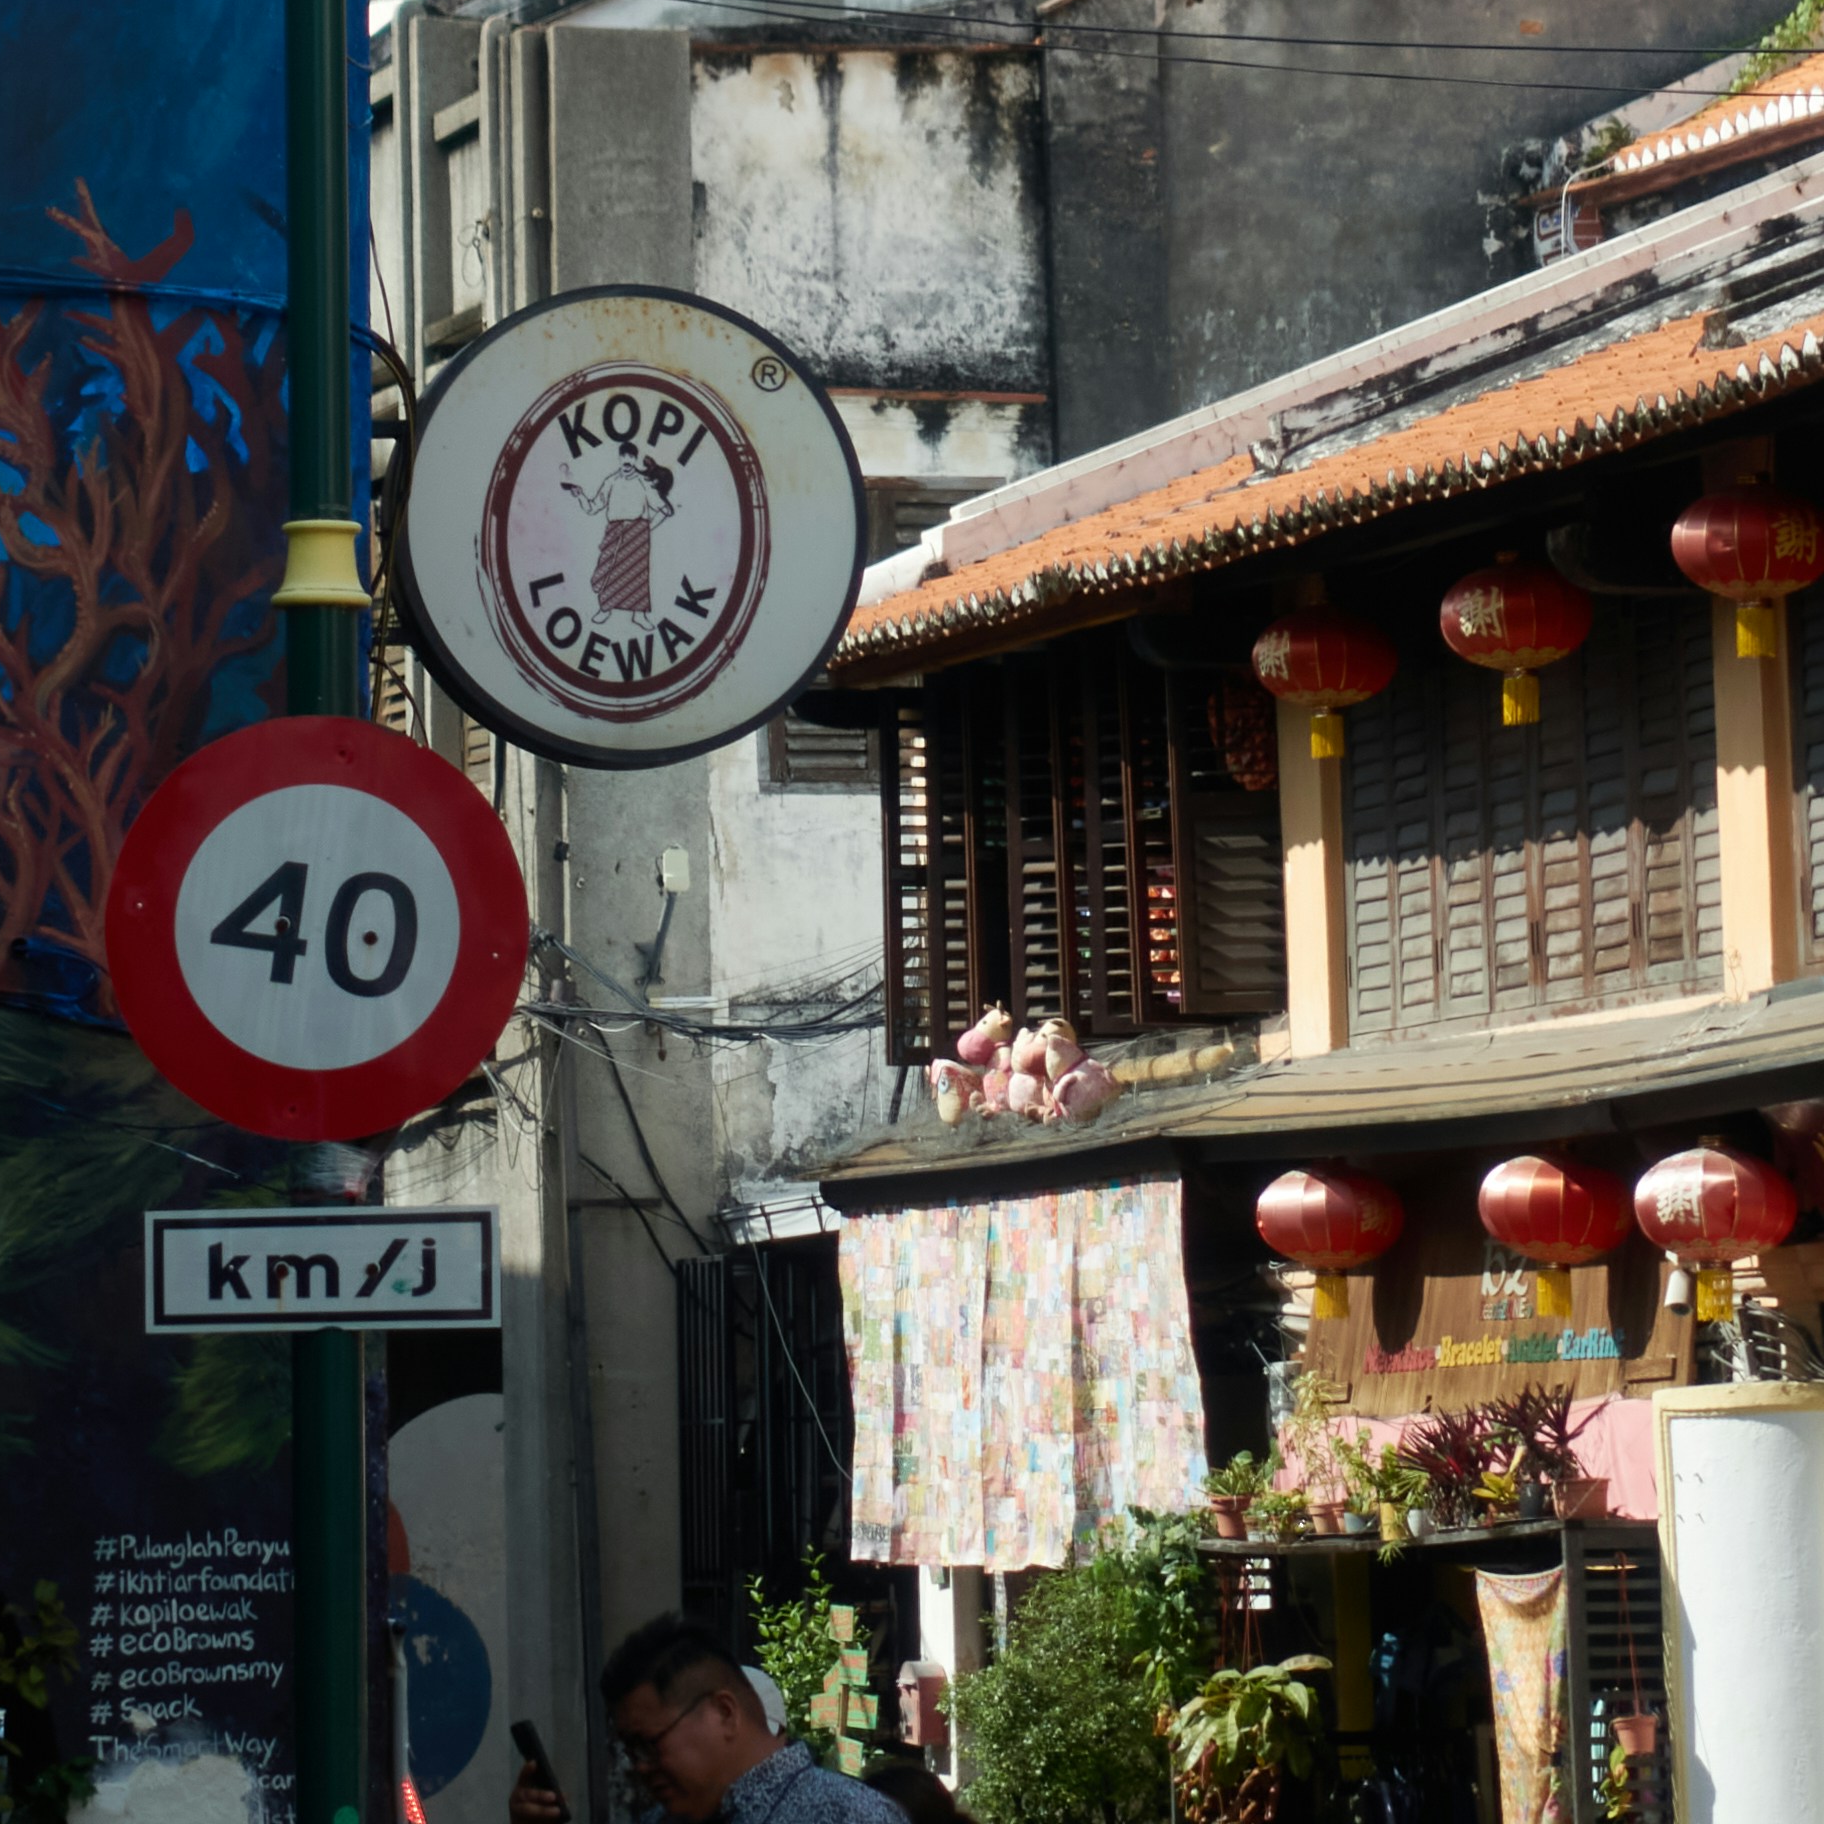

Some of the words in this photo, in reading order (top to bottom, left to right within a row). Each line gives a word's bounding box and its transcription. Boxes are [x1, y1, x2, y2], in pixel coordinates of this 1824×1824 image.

[558, 393, 710, 467] KOPI
[529, 571, 717, 682] LOEWAK
[210, 860, 418, 997] 40
[208, 1237, 438, 1299] km/j
[1438, 1333, 1503, 1368] Bracelet
[93, 1528, 291, 1568] #PulanglahPenyu
